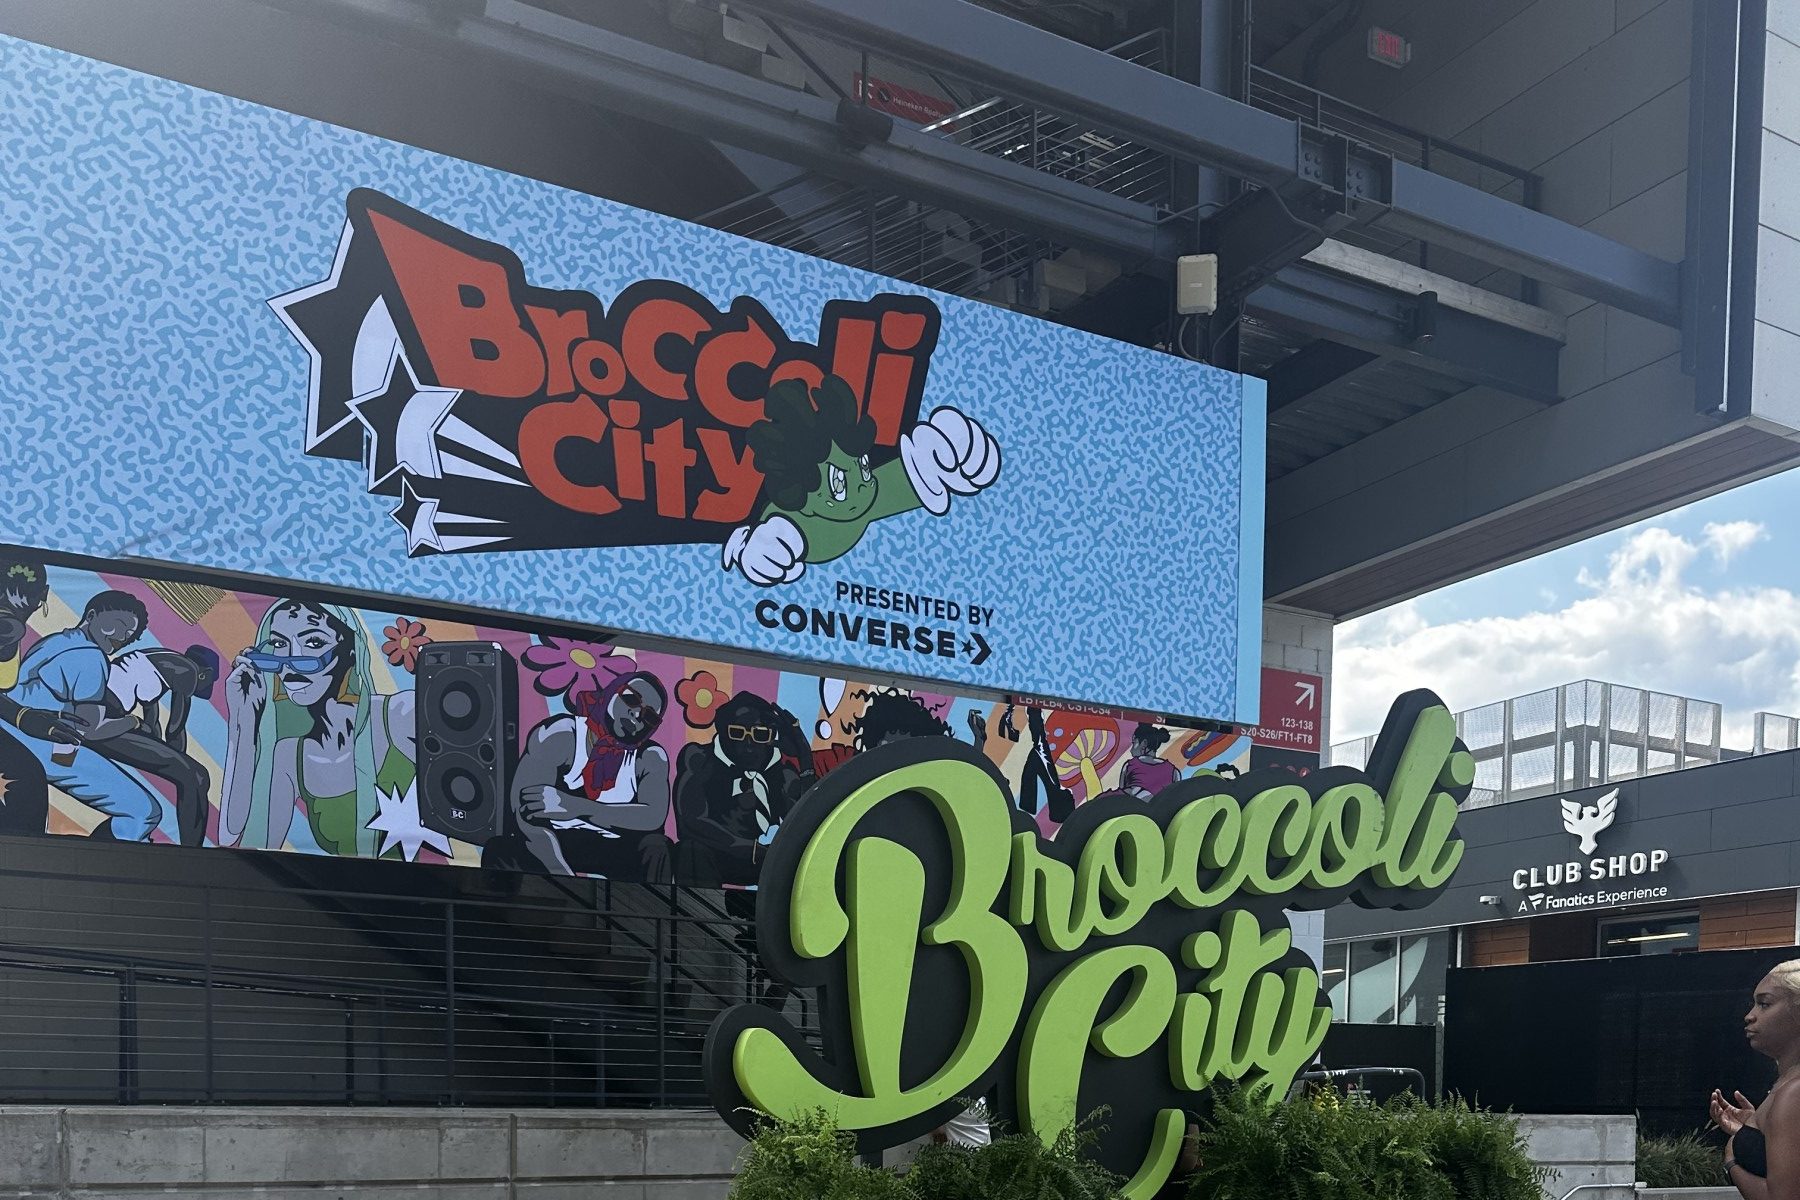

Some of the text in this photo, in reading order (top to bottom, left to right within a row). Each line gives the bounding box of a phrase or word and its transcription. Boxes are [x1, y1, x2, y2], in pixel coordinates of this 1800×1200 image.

[517, 394, 766, 523] City
[836, 580, 995, 628] PRESENTED BY
[754, 599, 956, 659] CONVERSE
[1240, 727, 1314, 745] S20-S26/FT1-FT8
[1280, 717, 1314, 731] 123-138
[452, 810, 464, 819] BC
[1512, 849, 1669, 890] CLUB SHOP
[733, 704, 1476, 1130] Broccoli
[1518, 885, 1668, 912] A Fanatics Experience
